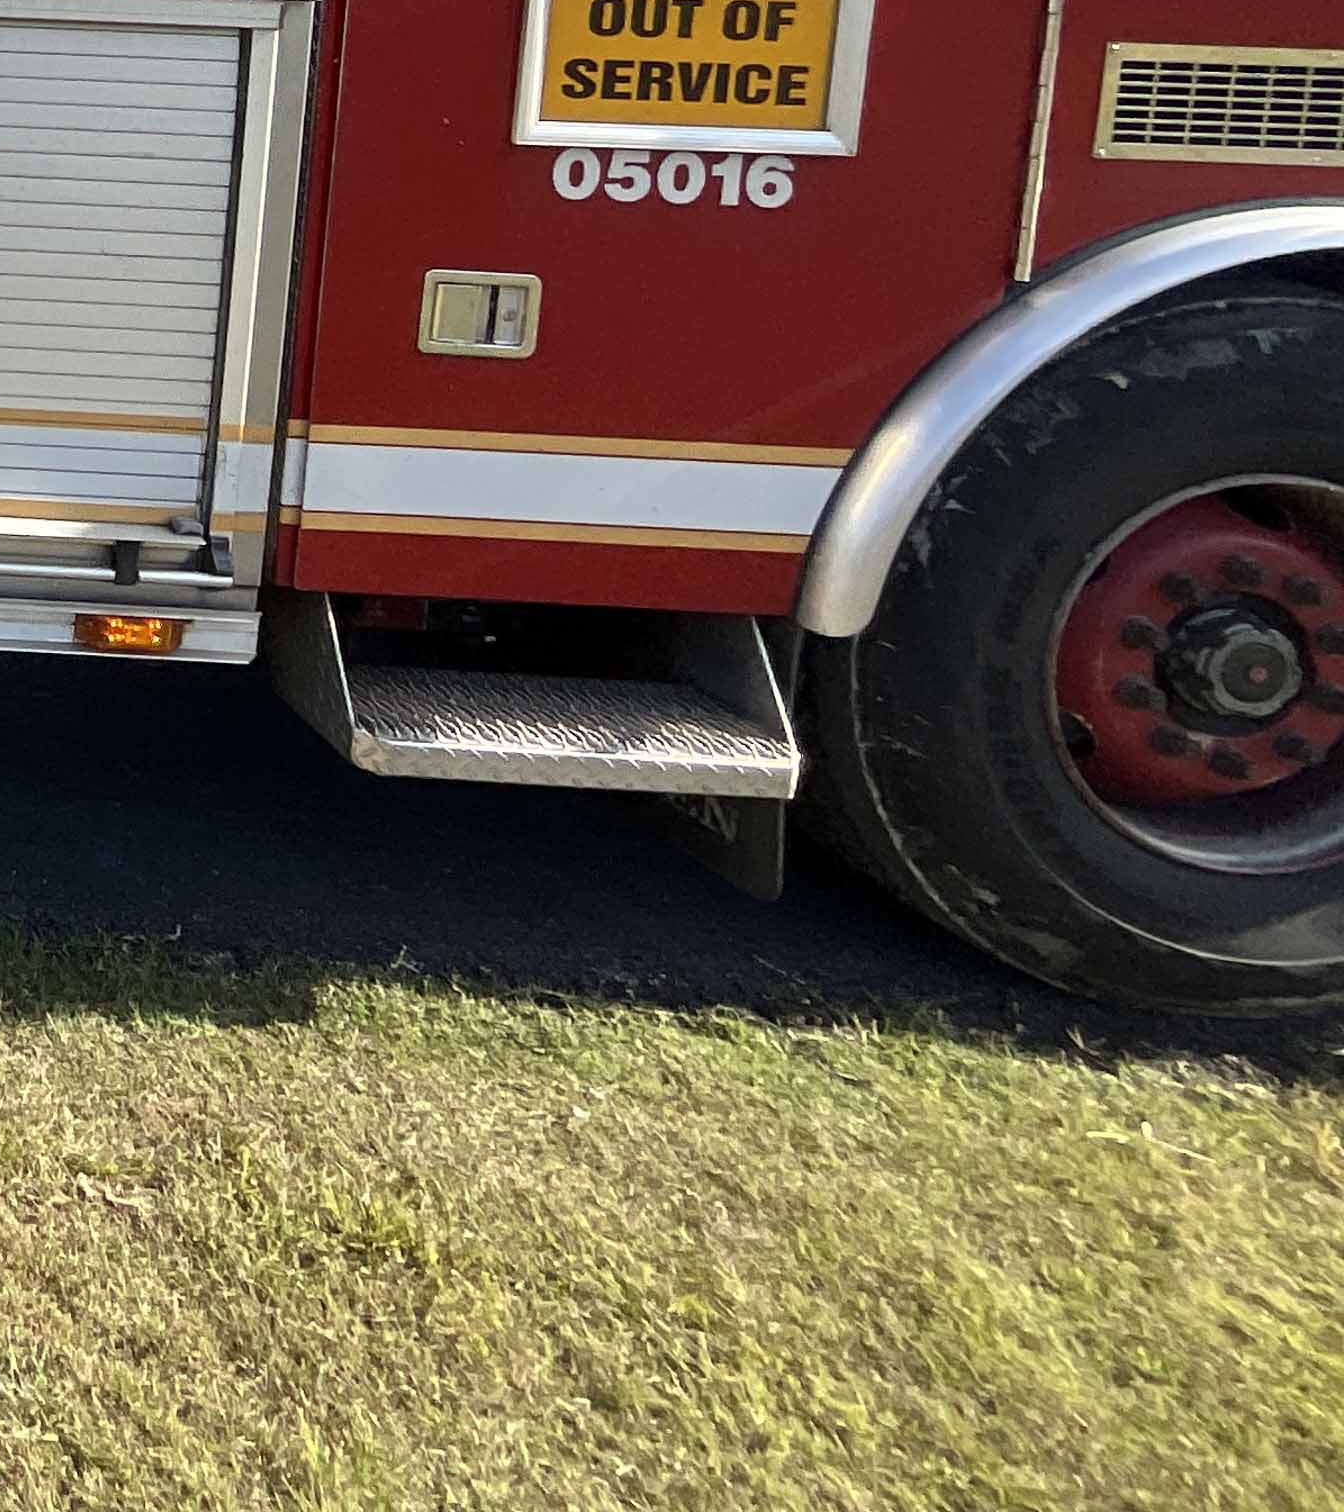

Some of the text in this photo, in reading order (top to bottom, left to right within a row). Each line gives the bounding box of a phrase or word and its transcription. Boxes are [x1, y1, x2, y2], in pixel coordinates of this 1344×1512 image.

[722, 0, 797, 41] OF
[561, 58, 810, 106] SERVICE
[553, 148, 795, 208] 05016
